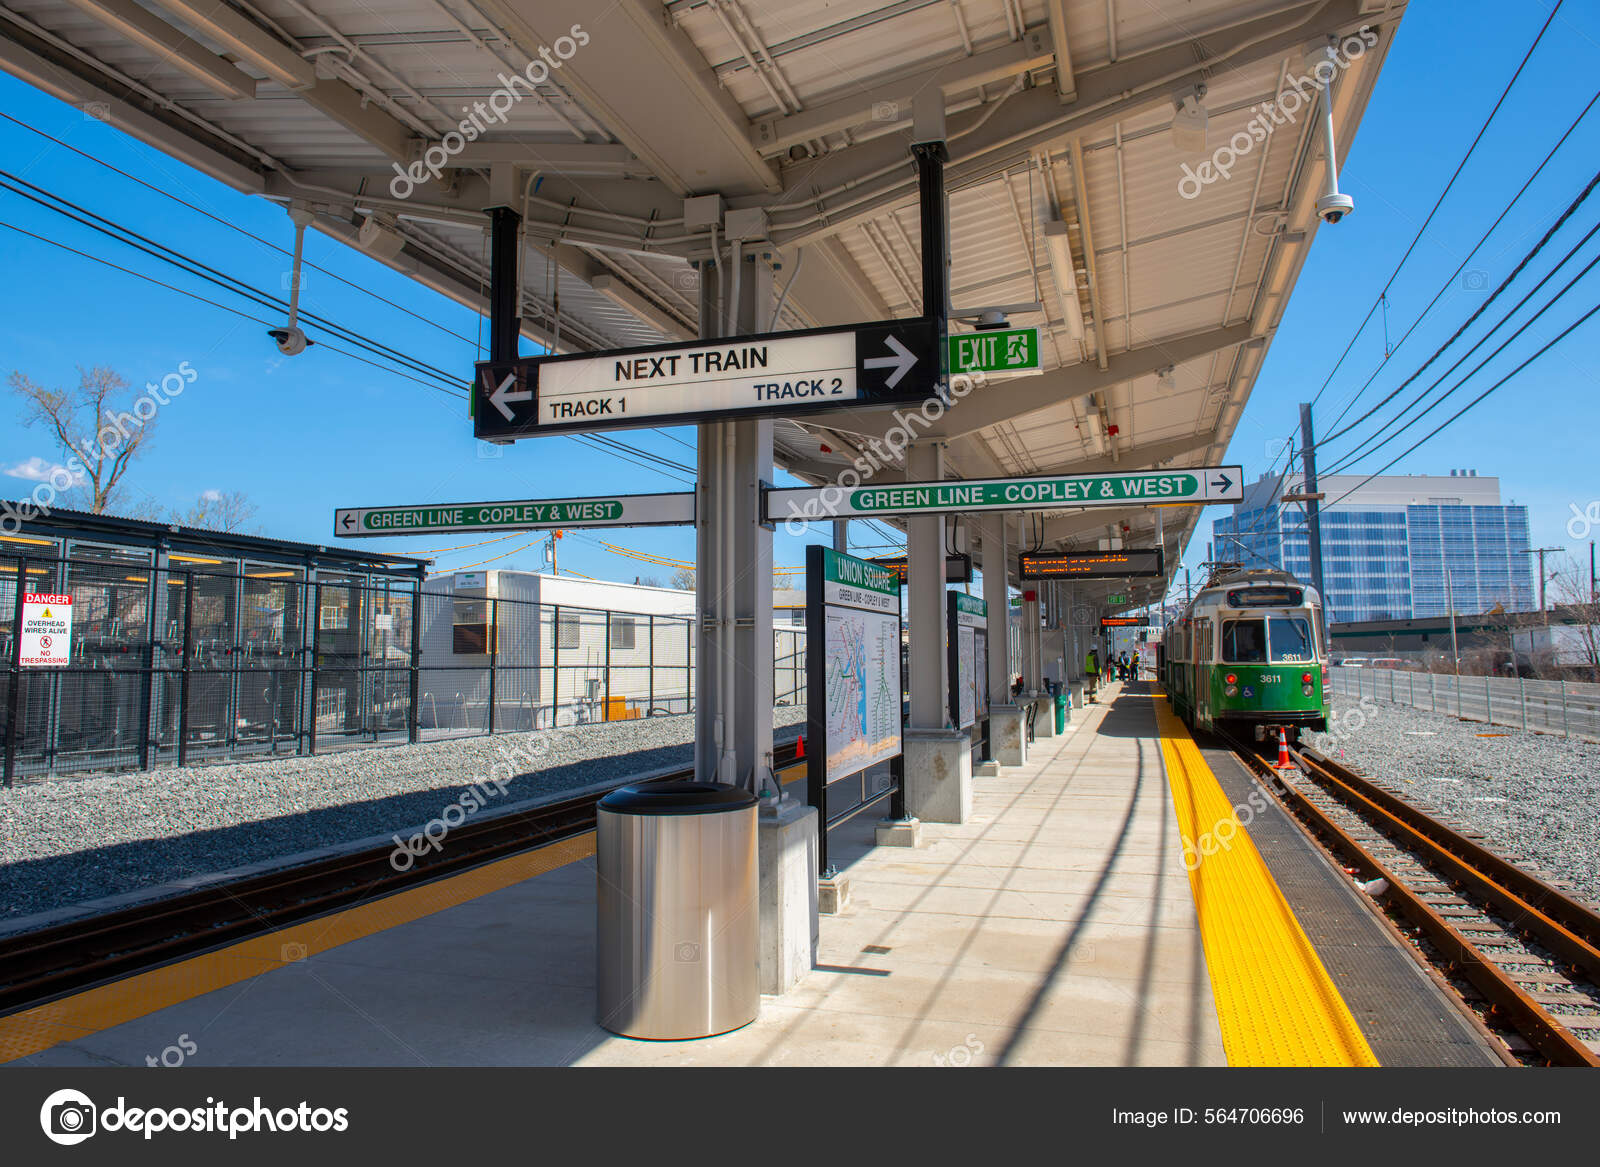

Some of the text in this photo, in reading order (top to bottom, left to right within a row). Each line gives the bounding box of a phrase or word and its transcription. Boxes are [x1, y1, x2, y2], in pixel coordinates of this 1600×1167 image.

[615, 346, 767, 381] NEXT TRAIN
[959, 337, 997, 368] EXIT
[753, 378, 843, 400] TRACK 2
[550, 397, 627, 418] TRACK 1
[859, 488, 930, 508] GREEN
[937, 487, 984, 505] LINE
[1005, 481, 1093, 501] COPLEY
[1100, 480, 1115, 497] &
[1121, 477, 1187, 496] WEST
[370, 511, 423, 528] GREEN
[428, 509, 464, 525] LINE
[479, 505, 545, 523] COPLEY
[549, 505, 560, 520] &
[566, 503, 616, 519] WEST
[838, 557, 863, 585] UNION
[864, 565, 891, 591] SQUARE
[26, 594, 69, 604] DANGER
[839, 588, 853, 602] GREEN
[853, 591, 862, 603] LINE
[865, 593, 878, 607] COPLEY
[881, 597, 890, 608] WEST
[1281, 654, 1301, 662] 3611
[1260, 674, 1282, 683] 3611
